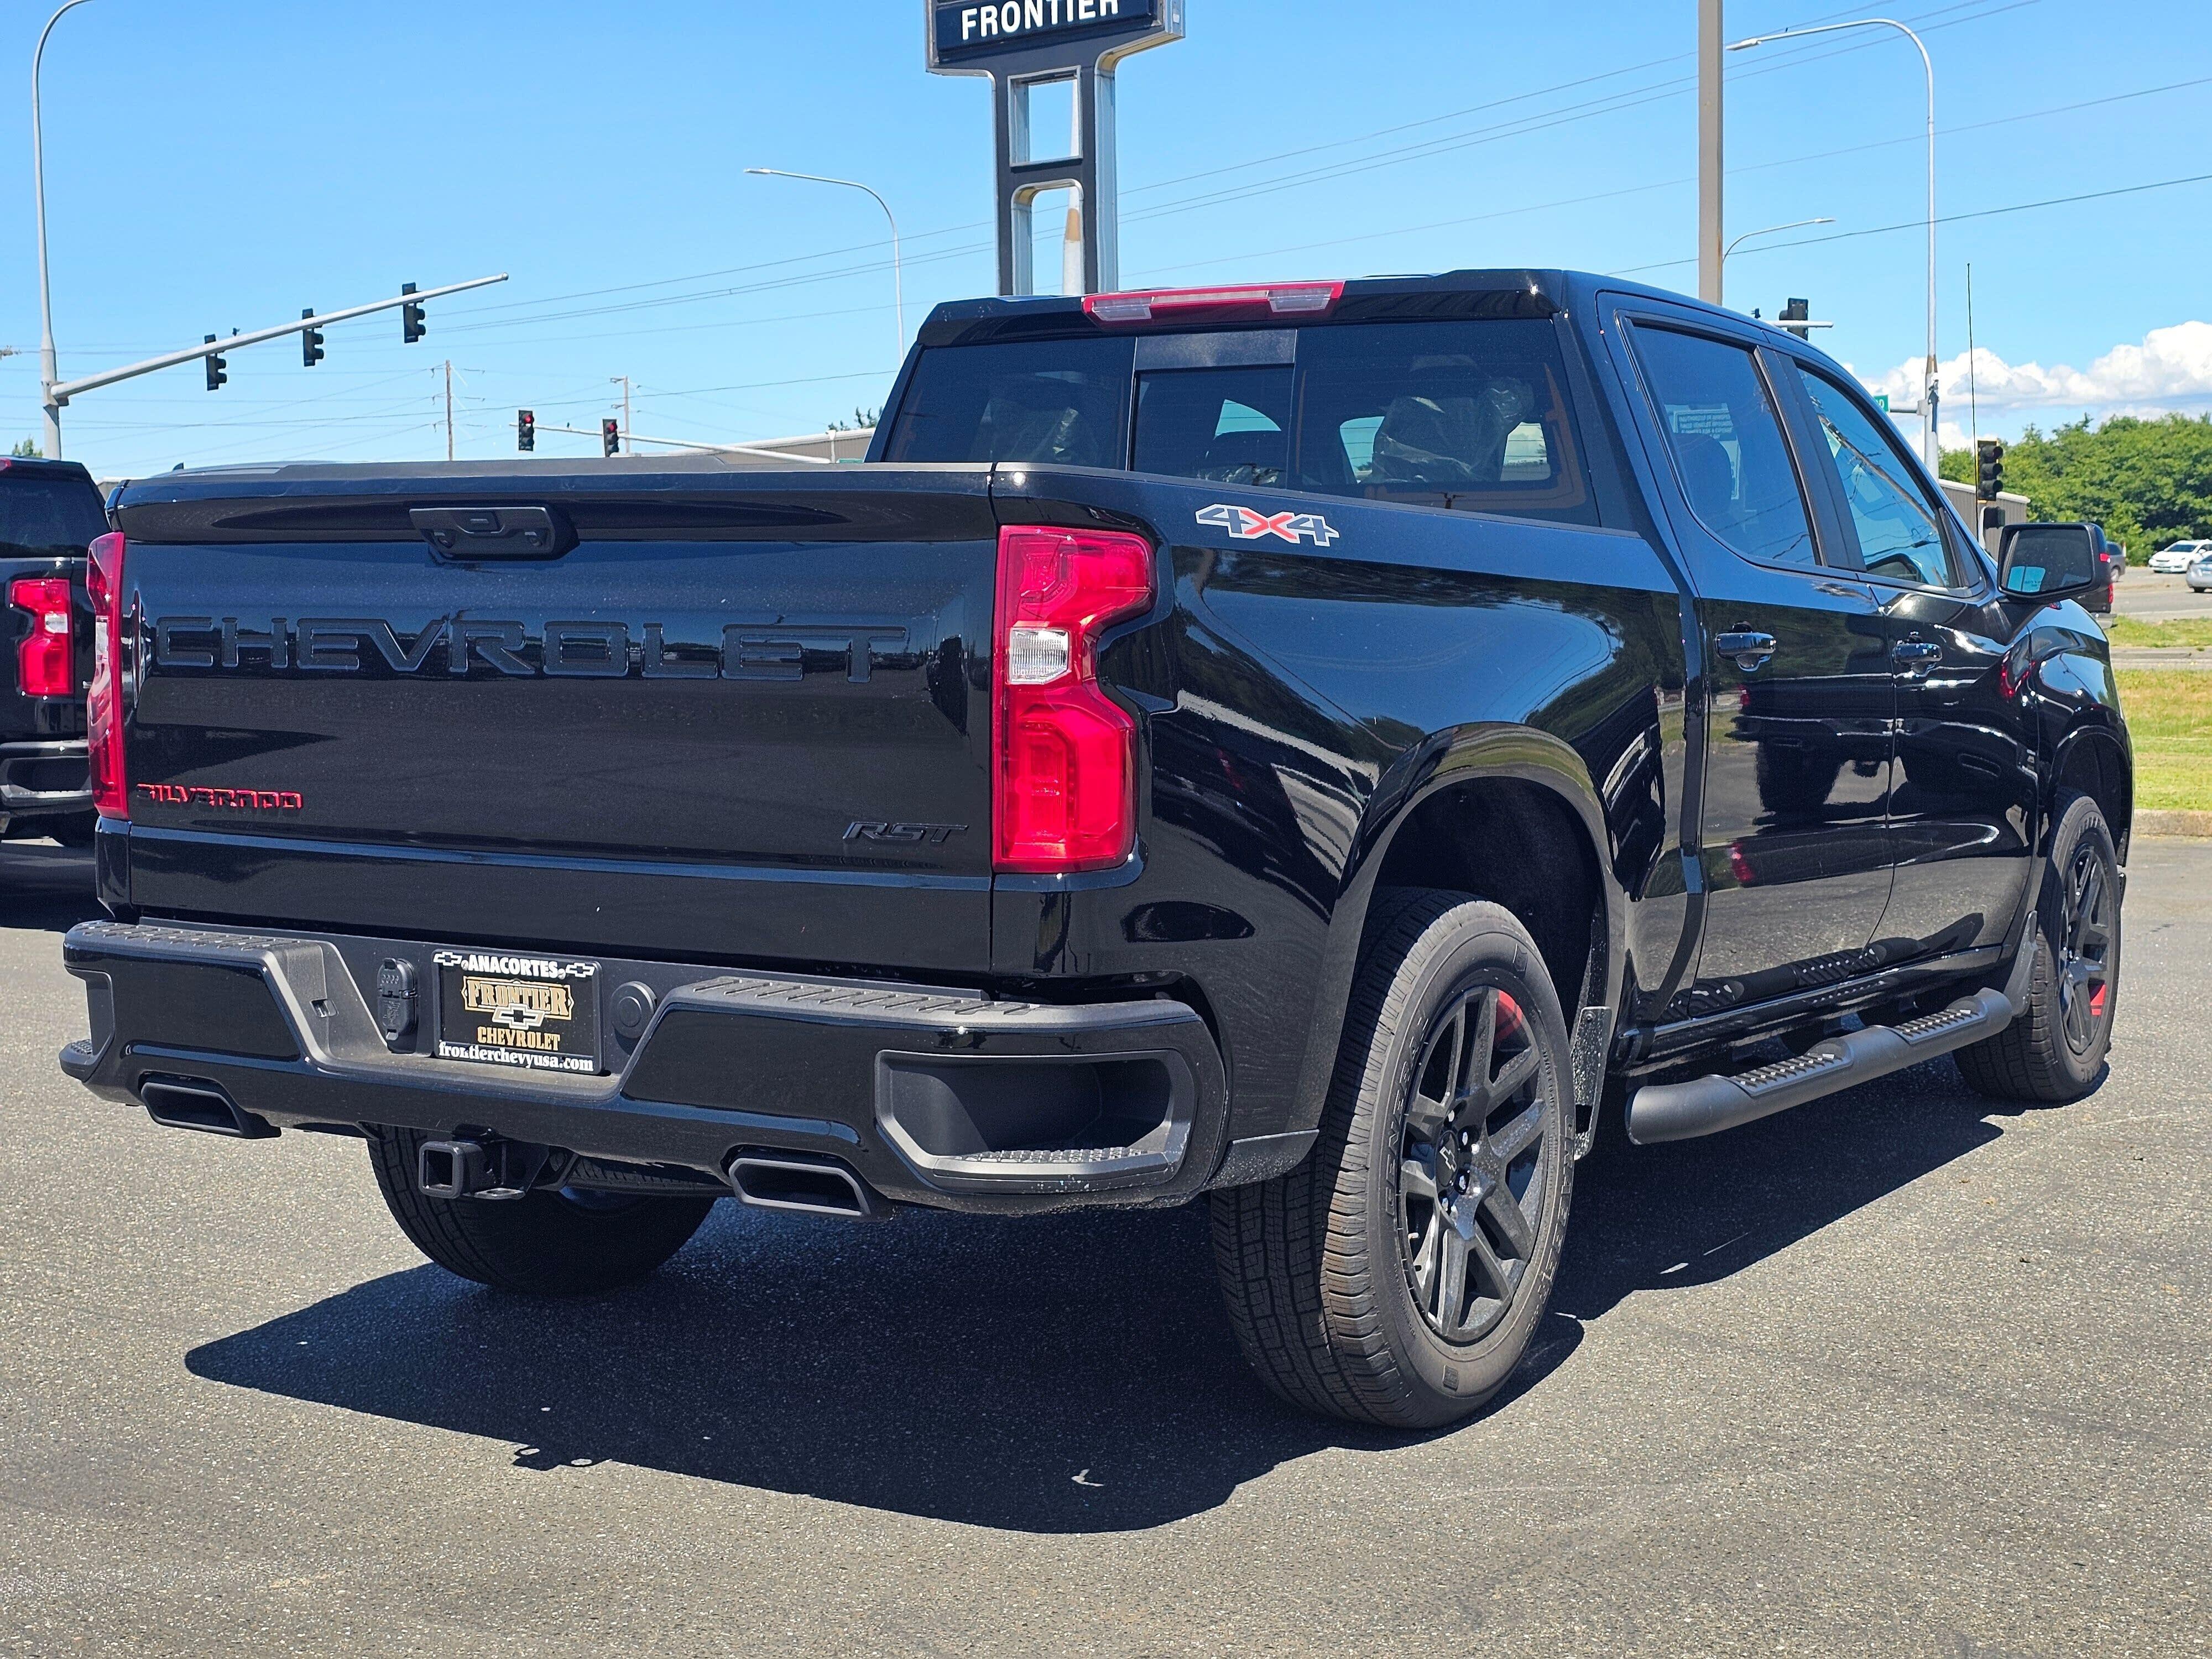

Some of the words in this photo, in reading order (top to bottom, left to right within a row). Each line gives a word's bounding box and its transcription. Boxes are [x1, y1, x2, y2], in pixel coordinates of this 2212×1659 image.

[156, 617, 907, 682] CHEVROLET
[137, 783, 302, 809] SILVERADO
[842, 821, 969, 843] RST
[469, 954, 559, 978] ANACORTES
[467, 979, 569, 1016] FRONTIER
[477, 1026, 560, 1051] CHEVROLET
[439, 1040, 594, 1072] frontierchevyusa.com
